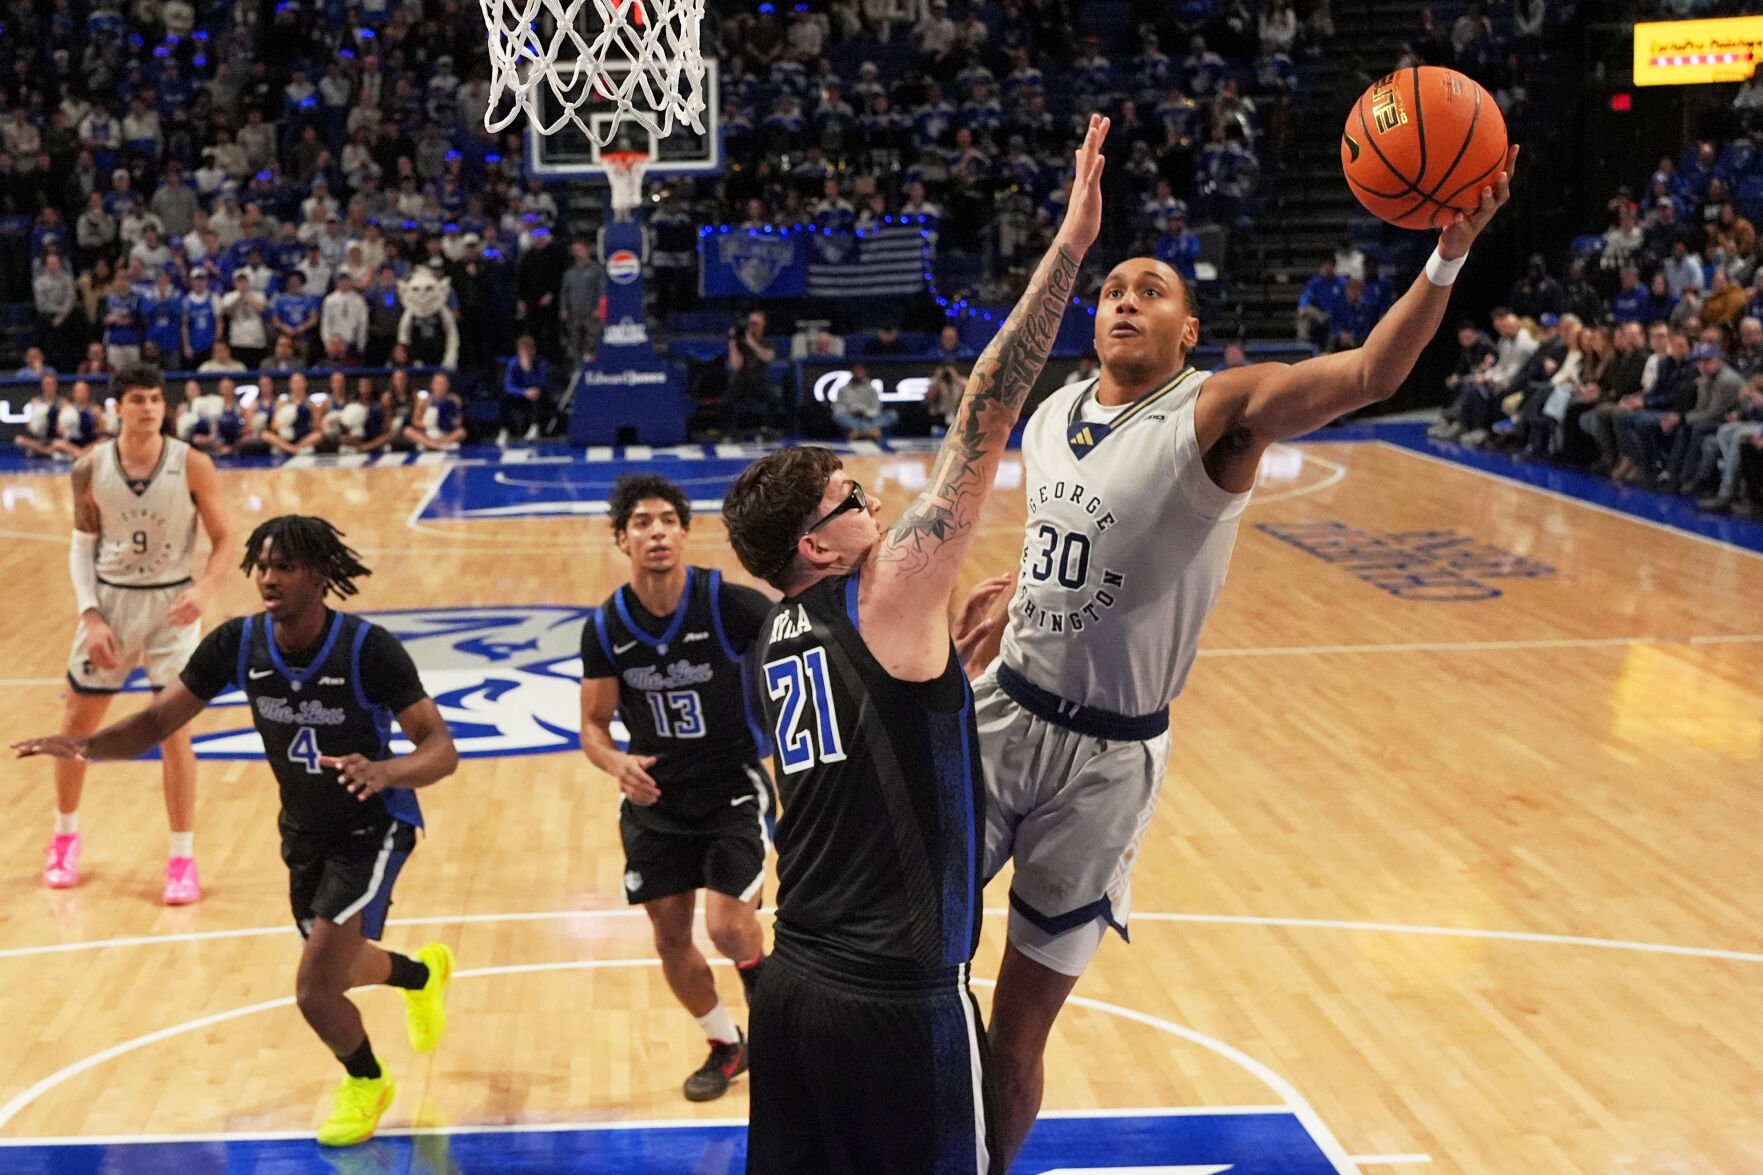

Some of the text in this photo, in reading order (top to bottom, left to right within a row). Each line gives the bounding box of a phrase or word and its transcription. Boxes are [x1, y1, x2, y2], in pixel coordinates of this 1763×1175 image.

[1029, 481, 1117, 532] GEORGE
[133, 530, 147, 555] 9
[1032, 524, 1091, 590] 30
[1020, 546, 1125, 633] WSHINGTON
[646, 690, 707, 739] 13
[763, 646, 847, 775] 21
[287, 726, 323, 774] 4
